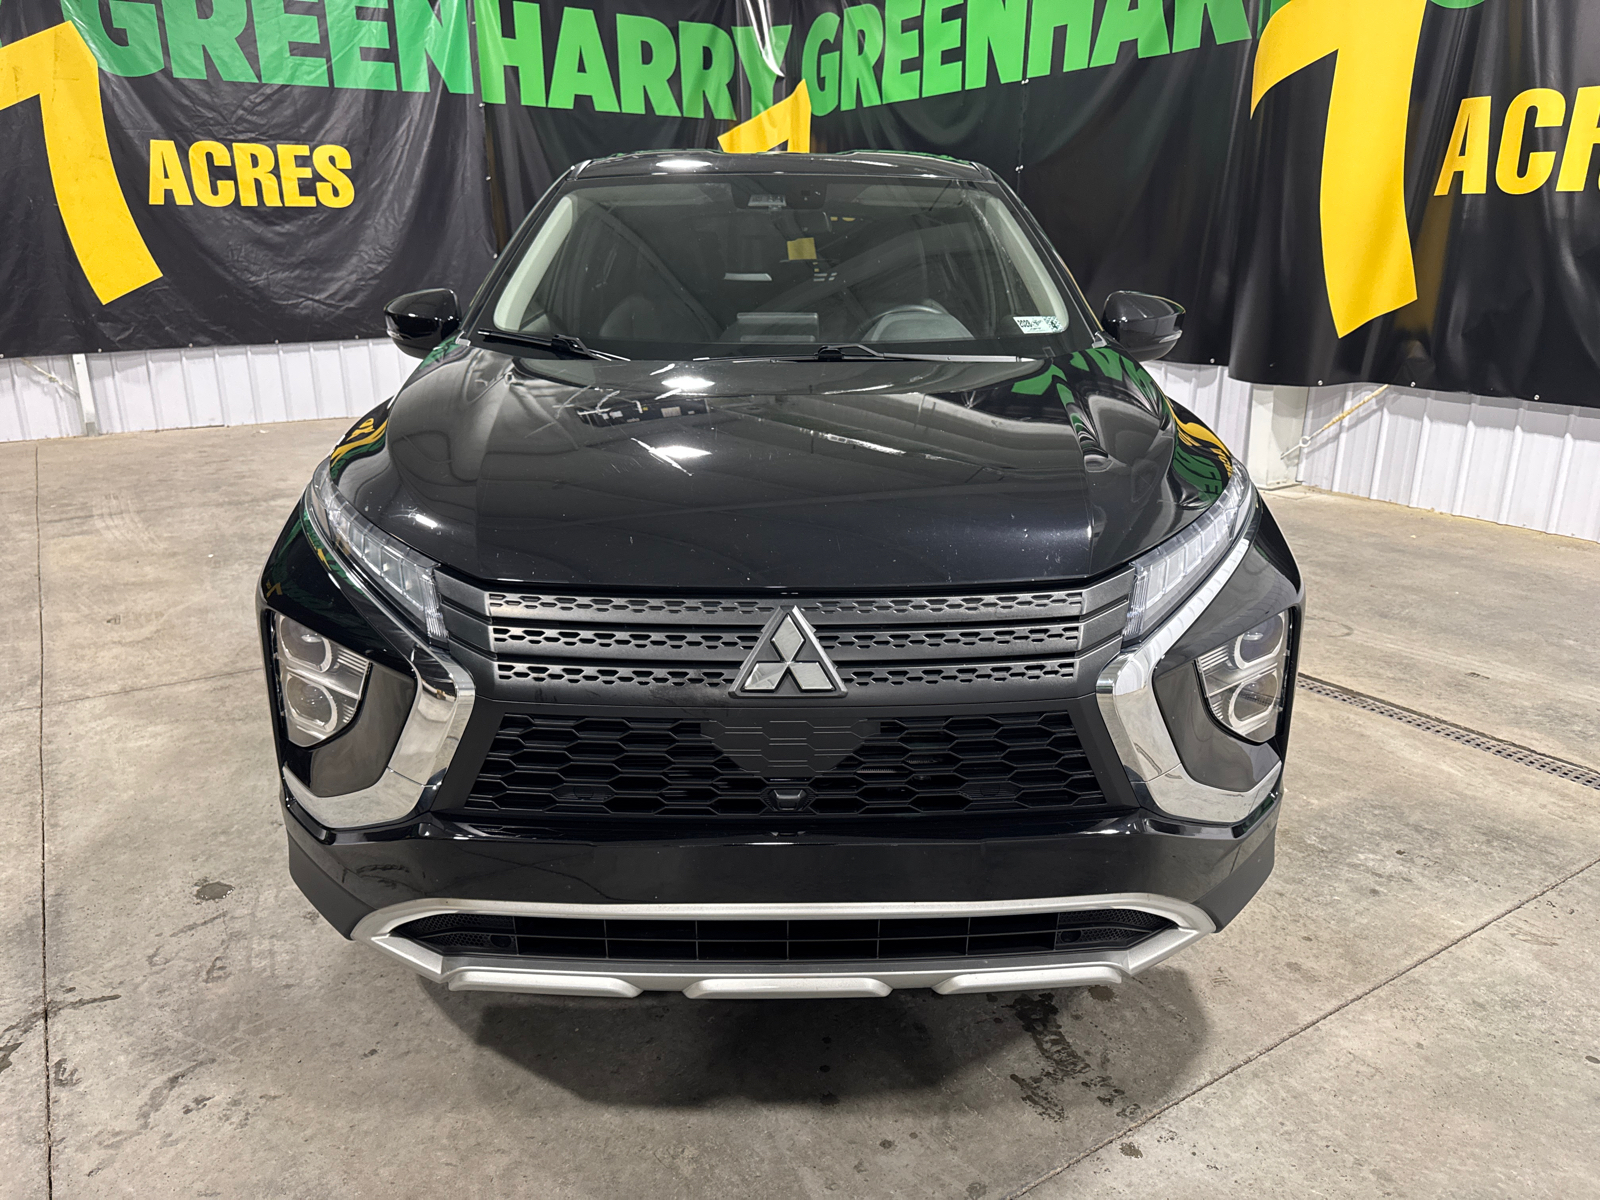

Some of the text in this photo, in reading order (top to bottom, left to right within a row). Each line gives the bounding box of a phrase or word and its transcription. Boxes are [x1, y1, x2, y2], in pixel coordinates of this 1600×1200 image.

[62, 0, 474, 94] GREEN
[476, 0, 793, 120] HARRY
[803, 0, 1024, 116] GREEN
[148, 139, 355, 208] ACRES
